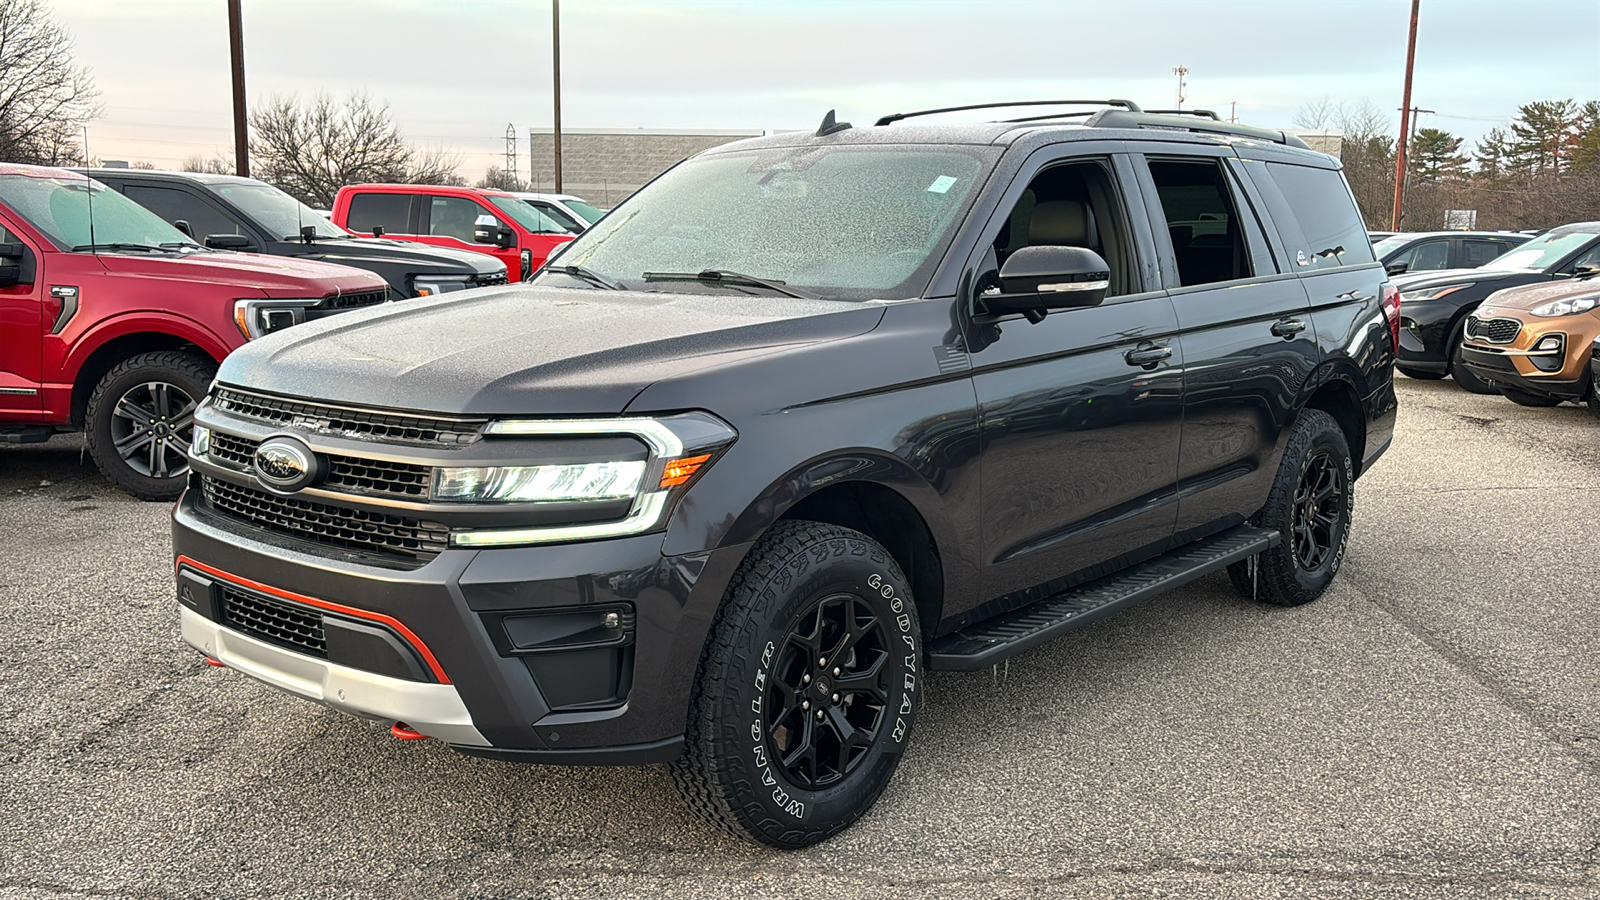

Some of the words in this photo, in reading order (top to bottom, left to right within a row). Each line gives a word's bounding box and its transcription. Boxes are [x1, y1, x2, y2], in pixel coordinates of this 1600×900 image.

[262, 450, 293, 476] Ford
[1331, 457, 1355, 573] GOODYEAR
[867, 573, 917, 743] GOODYEAR
[751, 641, 805, 819] WRANGLER
